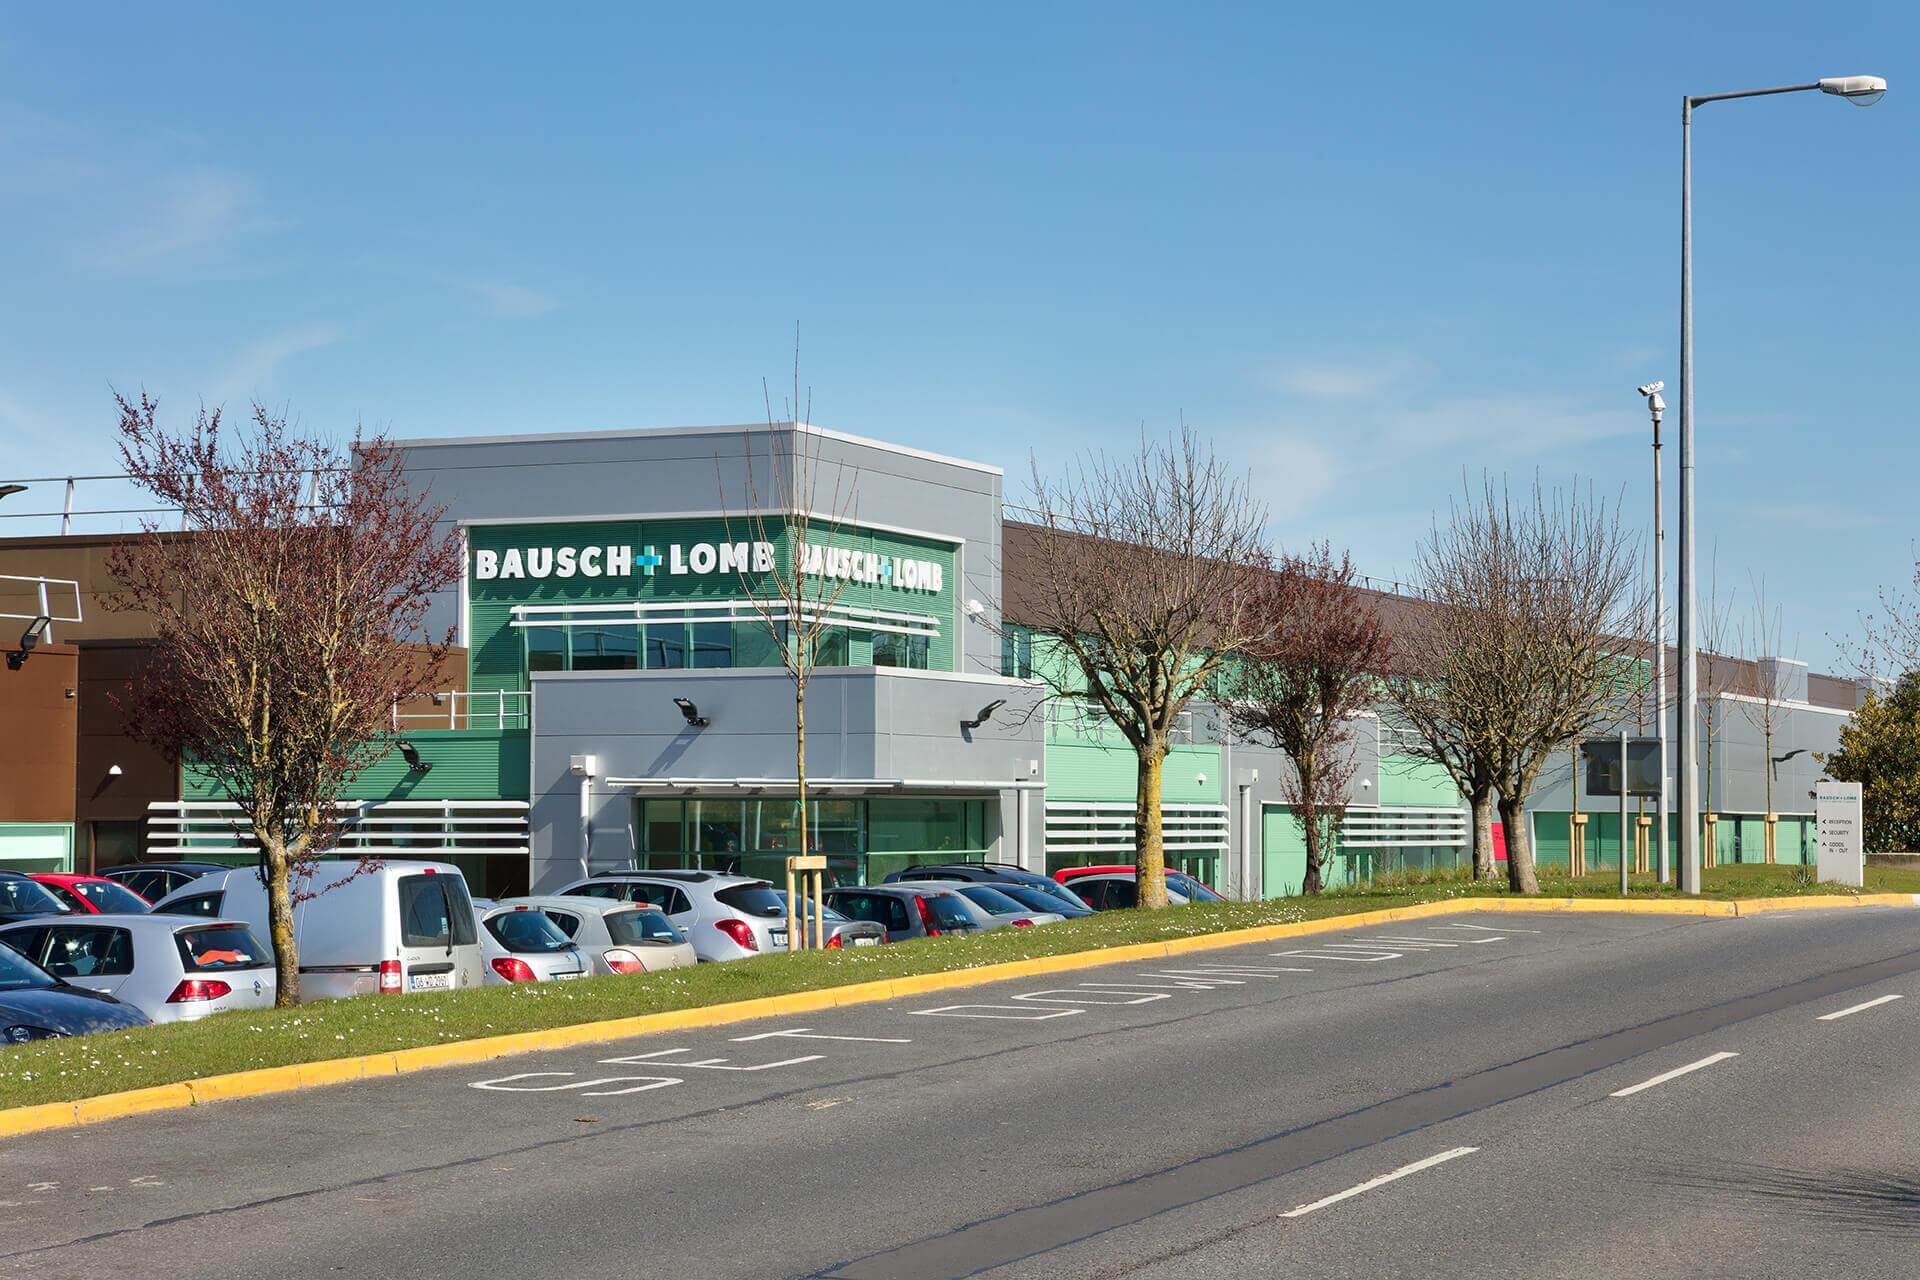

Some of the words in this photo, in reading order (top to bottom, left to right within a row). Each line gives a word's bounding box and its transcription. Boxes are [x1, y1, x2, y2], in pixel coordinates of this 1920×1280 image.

[476, 546, 631, 580] BAUSCH
[670, 542, 775, 575] LOMB
[892, 557, 943, 592] LOMB
[467, 1028, 911, 1096] SET
[907, 963, 1313, 1020] DOWN
[1268, 923, 1541, 961] ONLY
